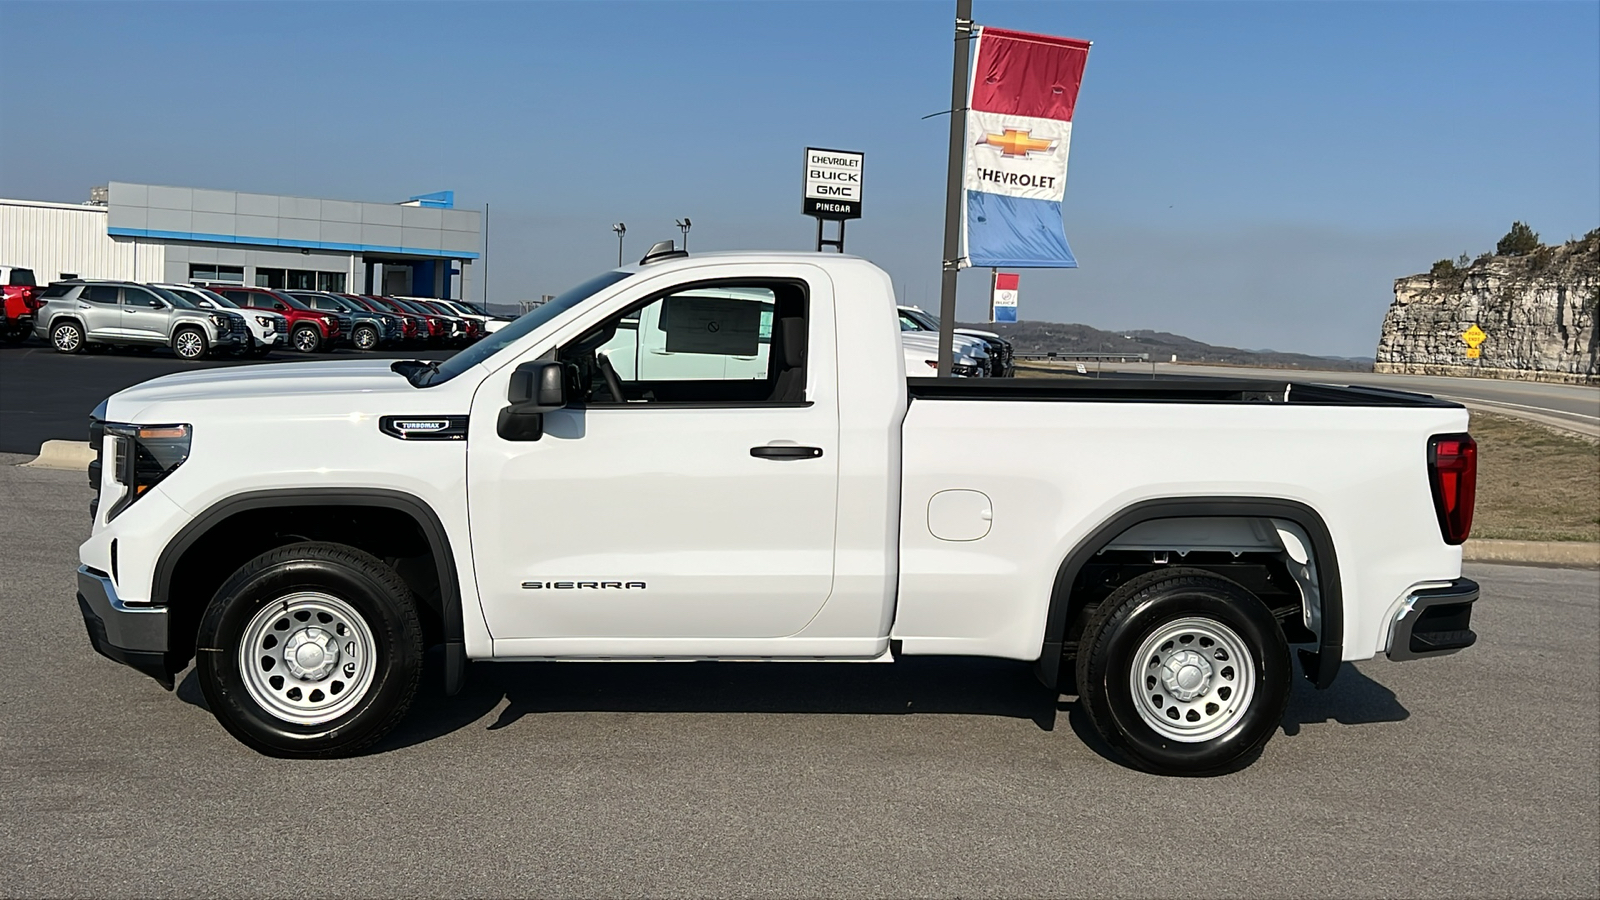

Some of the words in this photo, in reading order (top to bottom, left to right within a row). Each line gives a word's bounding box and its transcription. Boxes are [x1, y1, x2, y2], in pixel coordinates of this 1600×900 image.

[811, 155, 859, 168] CHEVROLET
[810, 169, 859, 183] BUICK
[816, 185, 852, 197] GMC
[815, 202, 851, 213] PINEGAR
[521, 581, 646, 590] SIERRA
